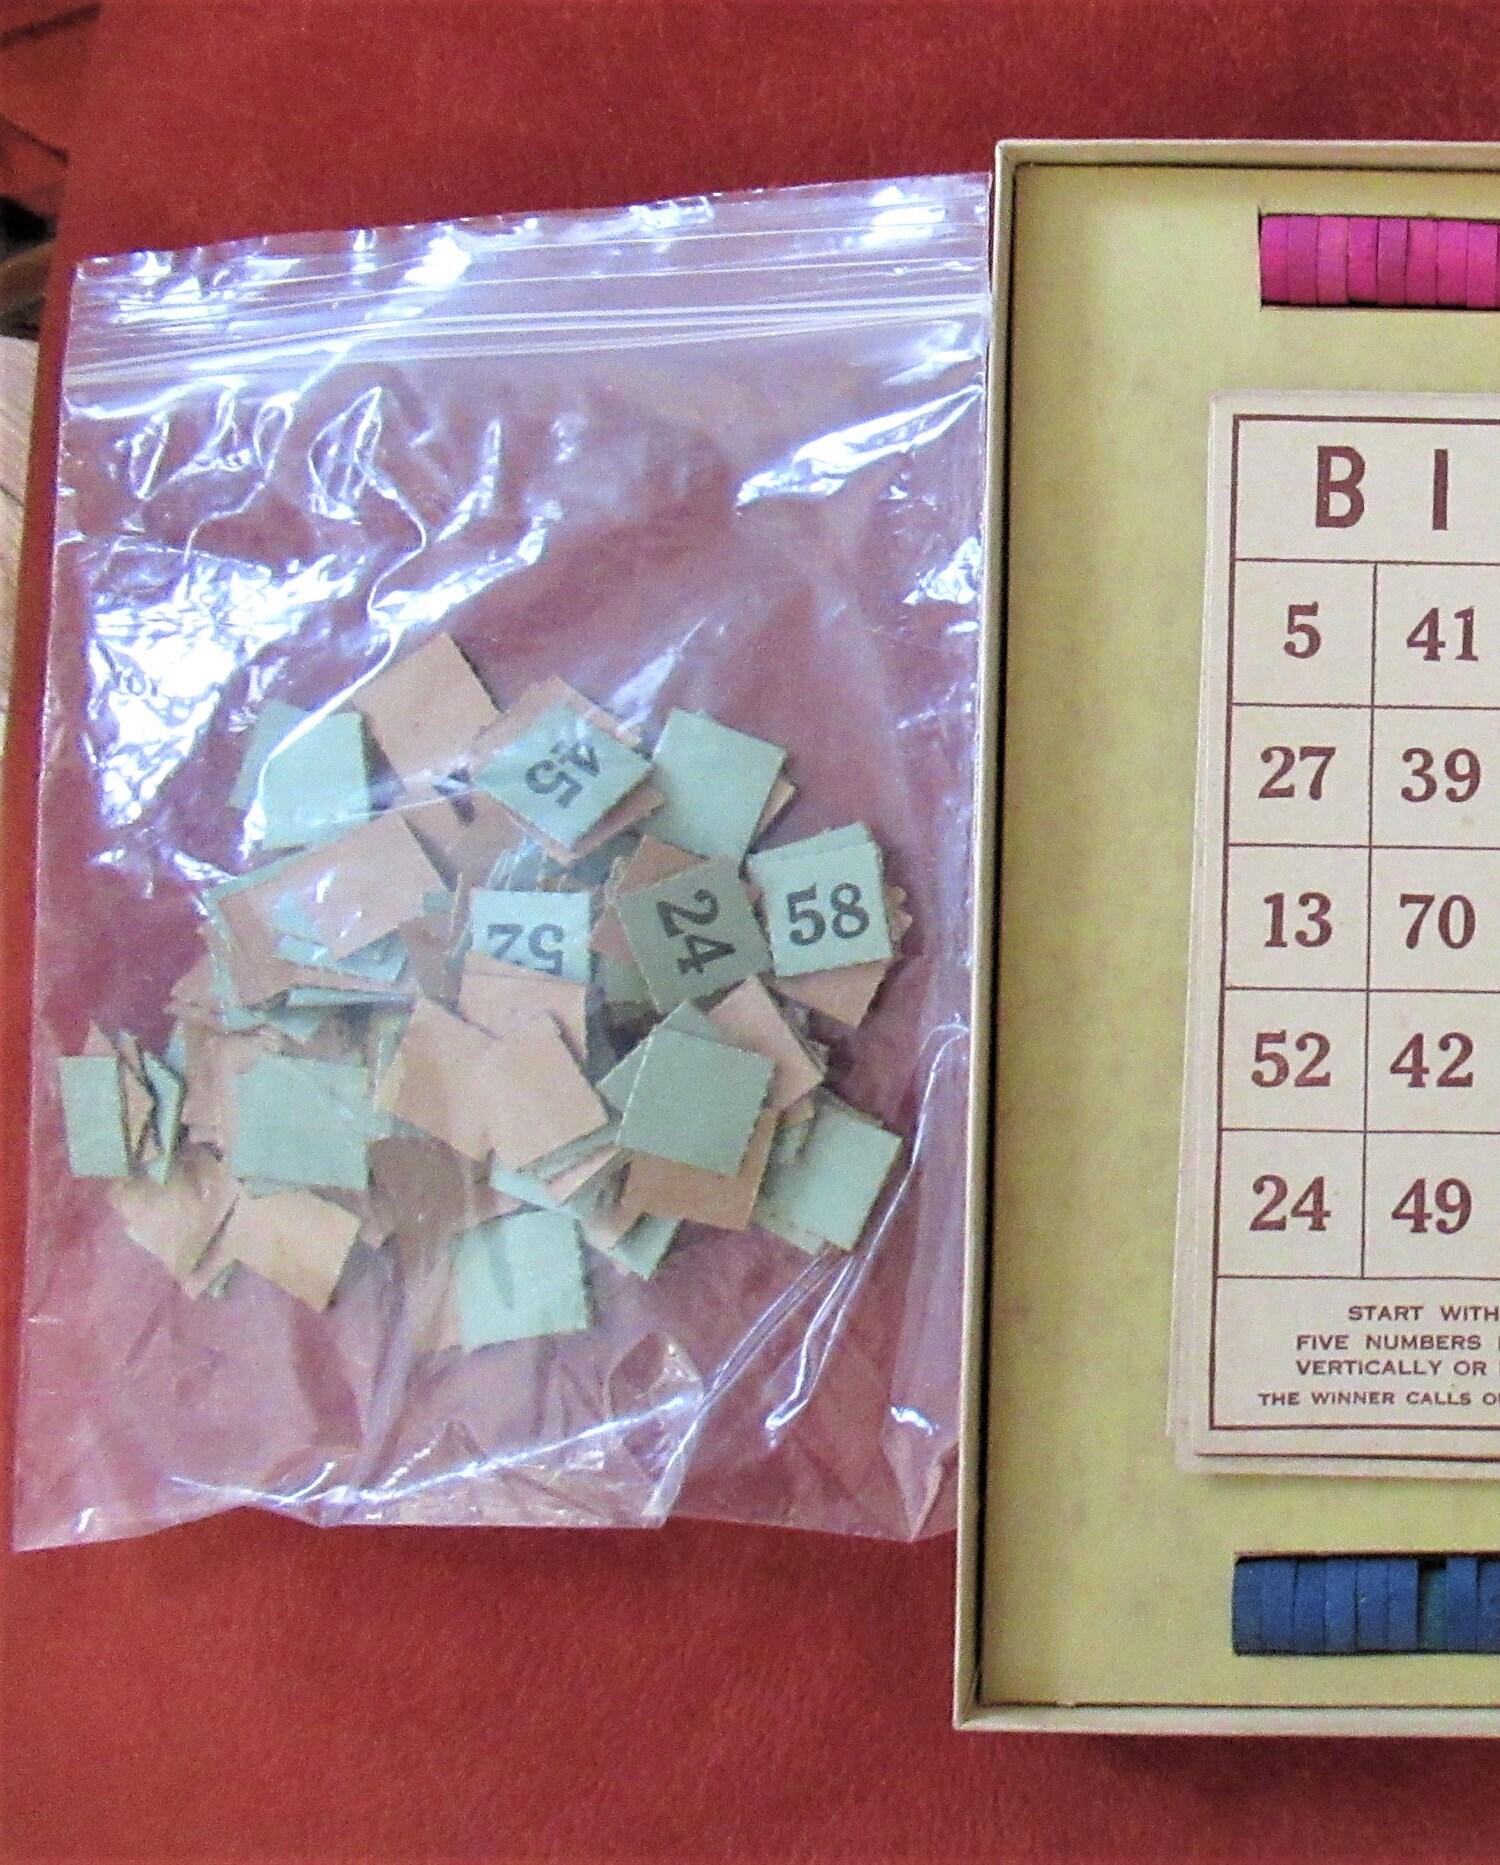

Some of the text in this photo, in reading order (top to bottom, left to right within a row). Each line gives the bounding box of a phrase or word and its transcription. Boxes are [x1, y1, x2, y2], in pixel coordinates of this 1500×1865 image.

[1284, 601, 1321, 659] 5
[1407, 607, 1478, 661] 41
[1259, 746, 1336, 800] 27
[1401, 748, 1481, 802] 39
[655, 885, 738, 978] 24
[787, 883, 869, 946] 58
[1264, 892, 1332, 947] 13
[1400, 894, 1475, 949] 70
[1252, 1030, 1330, 1087] 52
[1390, 1032, 1473, 1088] 42
[1250, 1175, 1331, 1231] 24
[1392, 1178, 1471, 1234] 49
[1349, 1305, 1424, 1321] START
[1440, 1306, 1499, 1321] WITH
[1296, 1360, 1442, 1375] VERTICALLY
[1454, 1360, 1486, 1376] OR
[1297, 1335, 1349, 1350] FIVE
[1366, 1335, 1481, 1350] NUMBERS
[1258, 1392, 1299, 1406] THE
[1311, 1391, 1394, 1404] WINNER
[1406, 1391, 1471, 1406] CALLS
